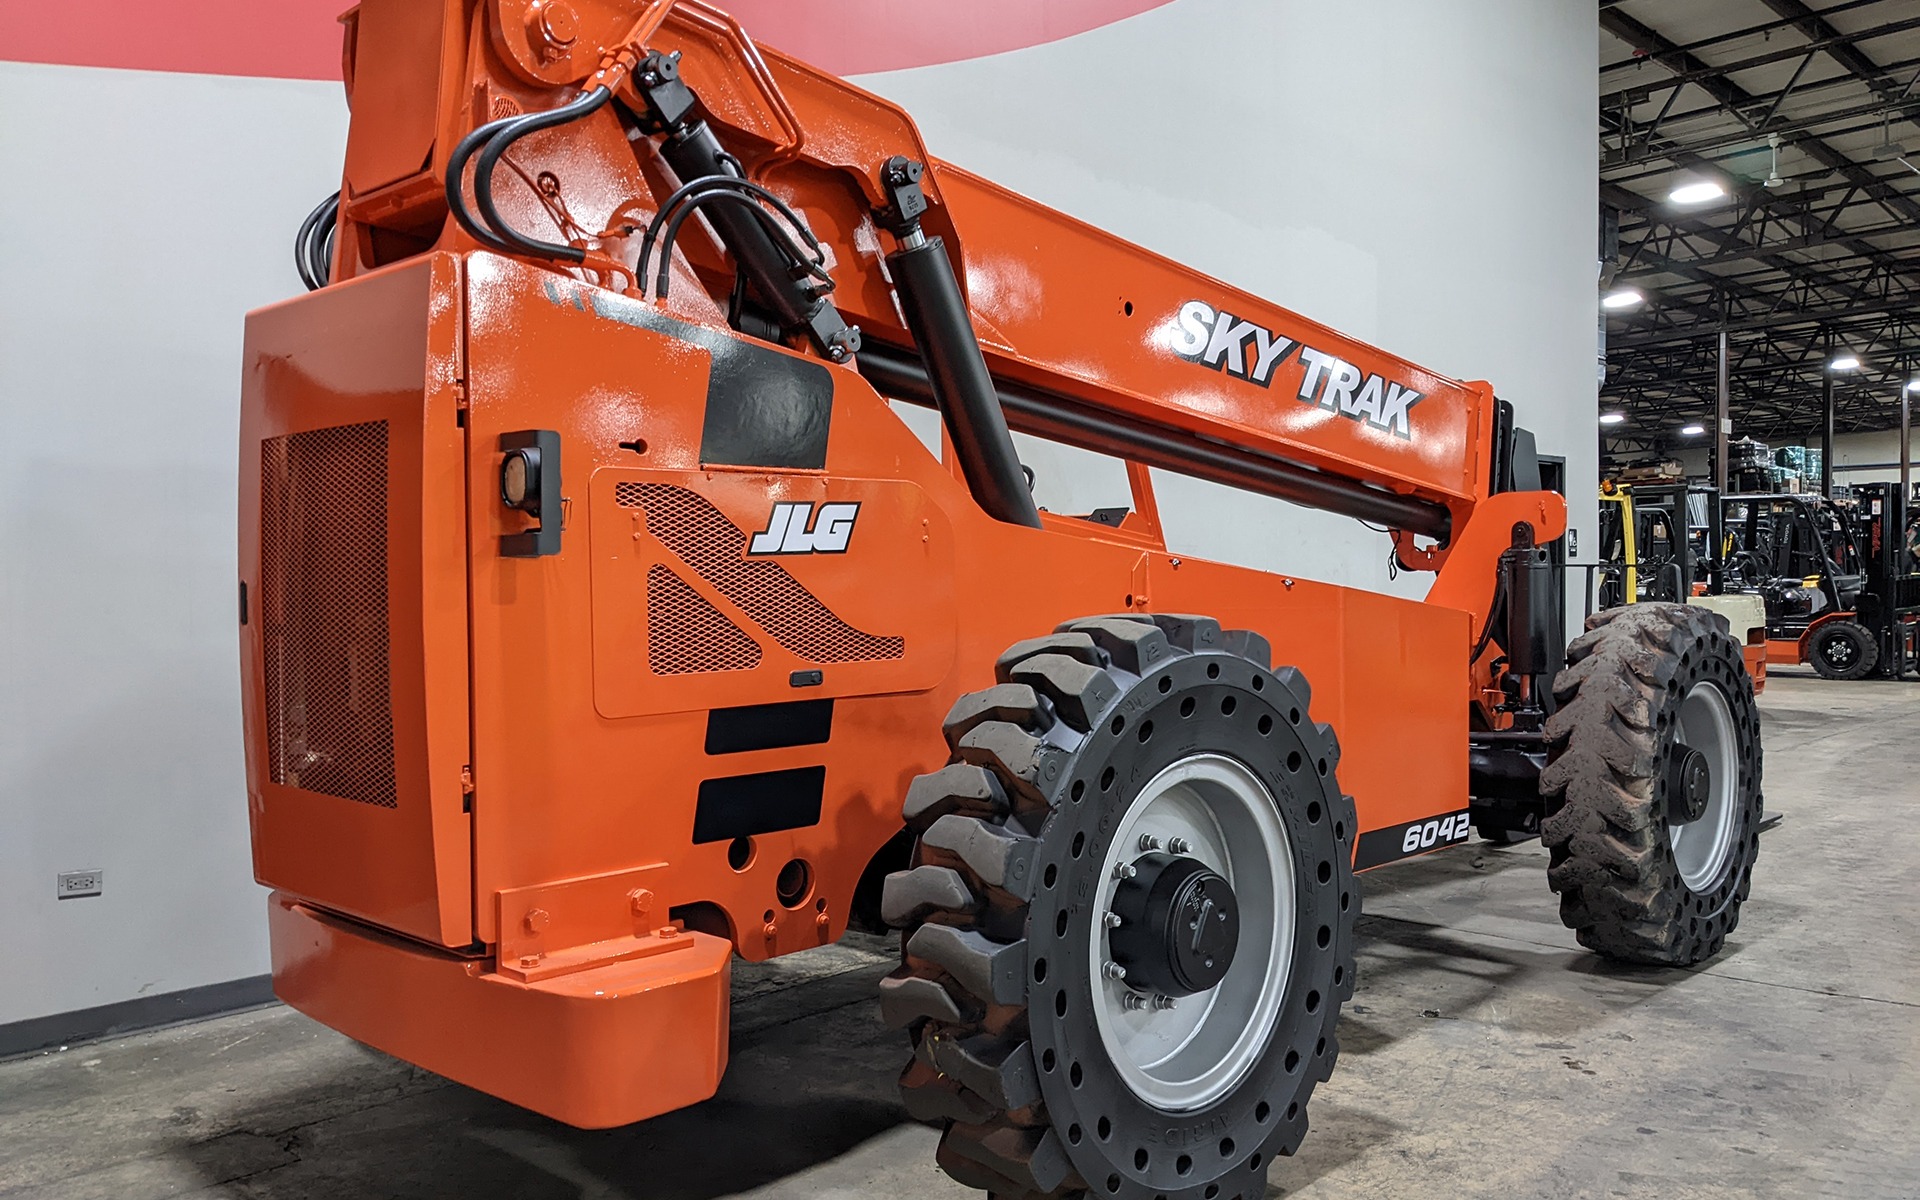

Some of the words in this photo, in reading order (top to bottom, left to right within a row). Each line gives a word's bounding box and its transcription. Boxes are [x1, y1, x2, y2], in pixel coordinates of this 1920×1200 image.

[1170, 300, 1299, 387] SKY
[1297, 345, 1424, 439] TRAK
[749, 502, 861, 555] JLG
[1402, 812, 1470, 853] 6042
